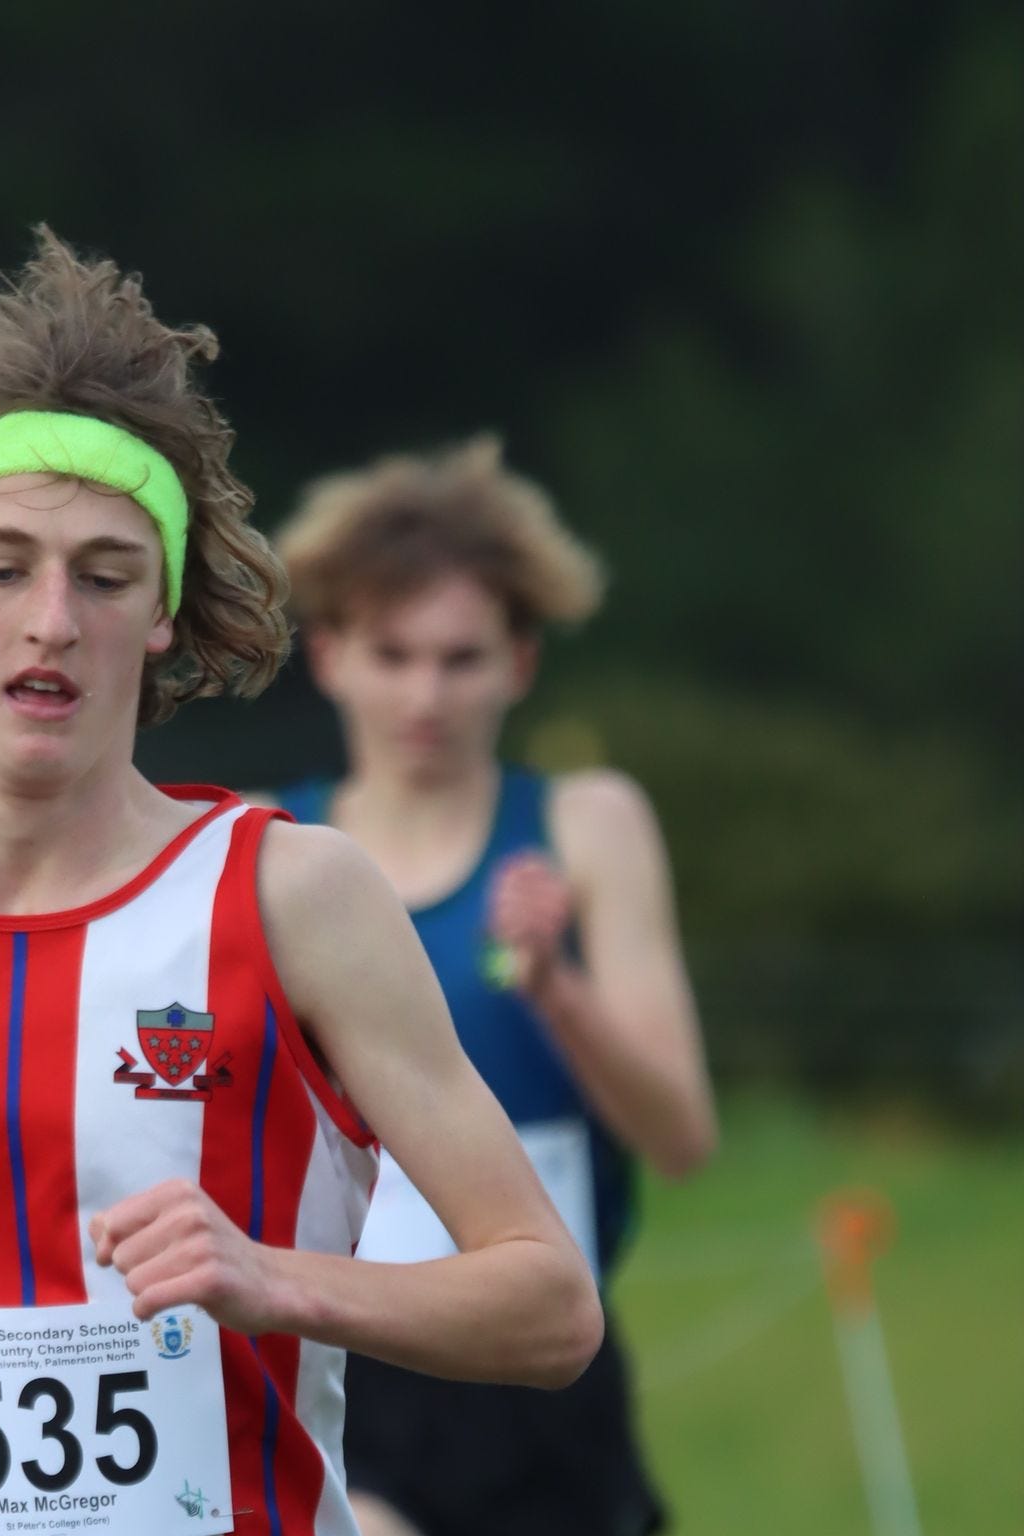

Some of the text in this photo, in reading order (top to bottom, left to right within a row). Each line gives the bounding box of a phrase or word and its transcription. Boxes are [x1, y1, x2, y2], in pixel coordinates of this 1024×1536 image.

[37, 1338, 141, 1356] Championships
[45, 1355, 104, 1367] Palmerston
[106, 1352, 136, 1362] North
[34, 1493, 118, 1513] McGregor
[6, 1515, 111, 1531] St Peter's College (Gore)
